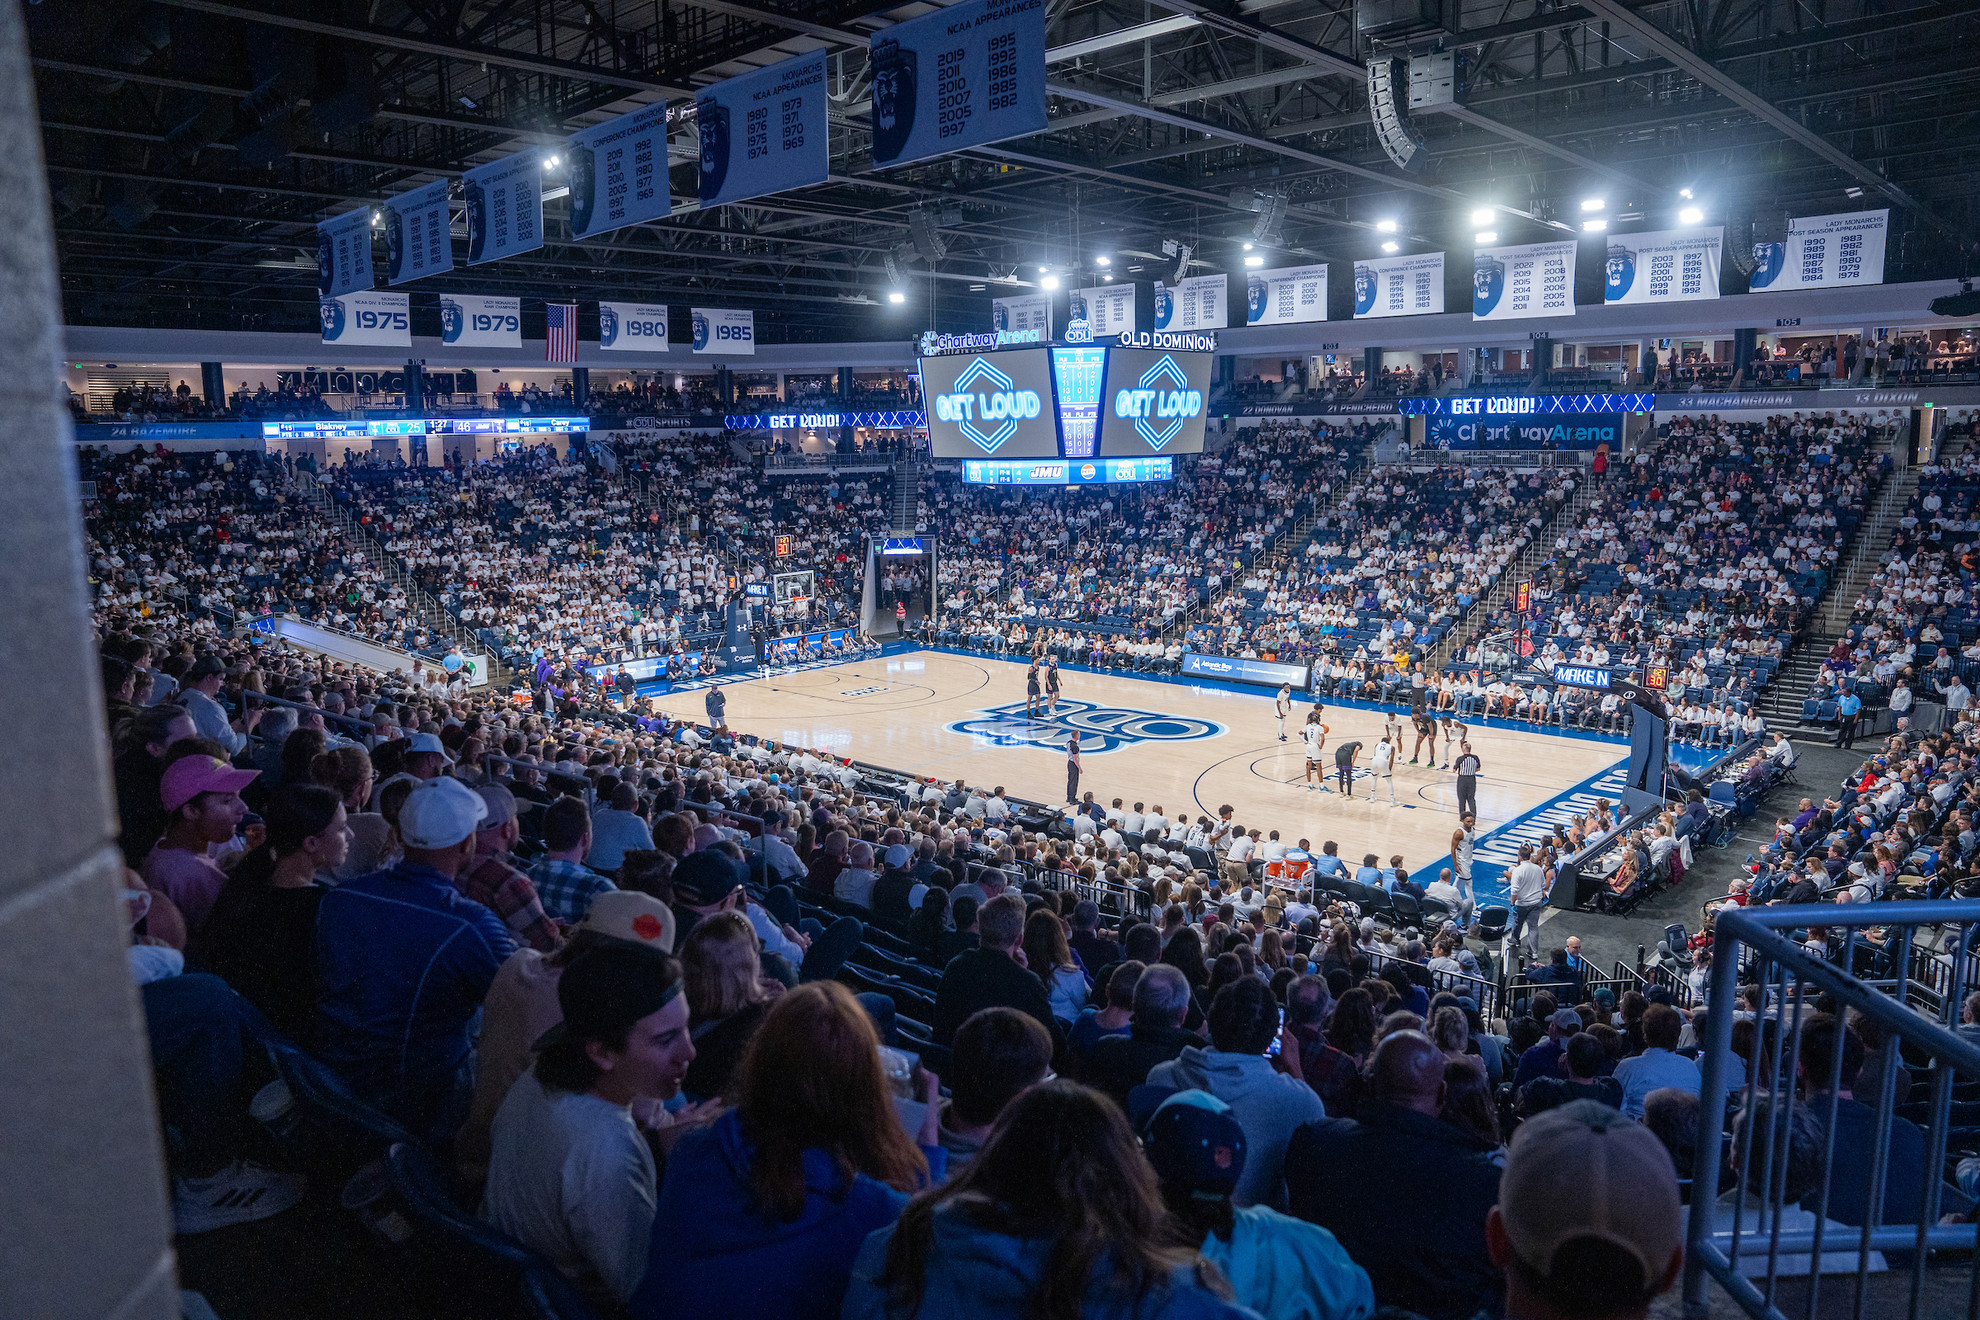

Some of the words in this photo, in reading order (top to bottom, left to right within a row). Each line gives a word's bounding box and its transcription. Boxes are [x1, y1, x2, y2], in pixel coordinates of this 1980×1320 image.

[948, 21, 971, 36] NCAA
[975, 0, 1041, 27] APPEARANCES
[988, 32, 1016, 50] 1995
[938, 49, 965, 66] 2019
[988, 48, 1016, 66] 1992
[782, 62, 822, 81] MONARCHS
[938, 66, 960, 81] 2011
[989, 63, 1016, 82] 1986
[753, 90, 771, 101] NCAA
[773, 74, 823, 96] APPEARANCES
[939, 78, 966, 96] 2010
[989, 78, 1017, 96] 1985
[782, 97, 802, 112] 1973
[939, 91, 970, 110] 2007
[989, 93, 1017, 111] 1982
[748, 107, 768, 122] 1980
[783, 112, 799, 125] 1971
[939, 106, 972, 124] 2005
[627, 117, 664, 135] CHAMPIONS
[748, 121, 767, 135] 1976
[783, 123, 803, 138] 1970
[940, 122, 965, 139] 1997
[748, 133, 767, 147] 1975
[783, 136, 804, 151] 1969
[748, 145, 768, 160] 1974
[636, 163, 653, 177] 1980
[609, 183, 627, 197] 2005
[1835, 223, 1883, 232] APPEARANCES
[1845, 216, 1883, 225] MONARCHS
[355, 311, 408, 330] 1975
[472, 315, 519, 332] 1979
[627, 321, 665, 337] 1980
[717, 325, 752, 340] 1985
[1065, 329, 1094, 343] ODU
[1121, 331, 1150, 346] OLD
[1153, 333, 1214, 350] DOMINION
[936, 394, 974, 420] GET
[981, 390, 1041, 420] LOUD
[1115, 389, 1155, 418] GET
[1158, 389, 1202, 417] LOUD
[1452, 398, 1483, 414] GET
[1487, 397, 1535, 413] LOUD!
[1678, 397, 1694, 407] 33
[1697, 395, 1792, 407] MACHANGUANA
[1856, 393, 1868, 403] 13
[1871, 392, 1918, 402] DIXON
[1255, 405, 1294, 414] DONOVAN
[1340, 403, 1392, 412] PENICHEIRO
[316, 423, 347, 432] Blakney
[407, 423, 420, 433] 25
[458, 422, 470, 431] 46
[770, 415, 796, 428] GET
[800, 414, 840, 428] LOUD!
[112, 427, 126, 437] 24
[1030, 466, 1063, 478] JMU
[1116, 468, 1136, 480] ODU
[778, 544, 788, 555] 30
[1519, 593, 1526, 610] 30
[1201, 661, 1221, 669] Atlantic
[1557, 666, 1594, 683] MAKE
[1598, 672, 1608, 685] N
[1650, 677, 1662, 686] 30
